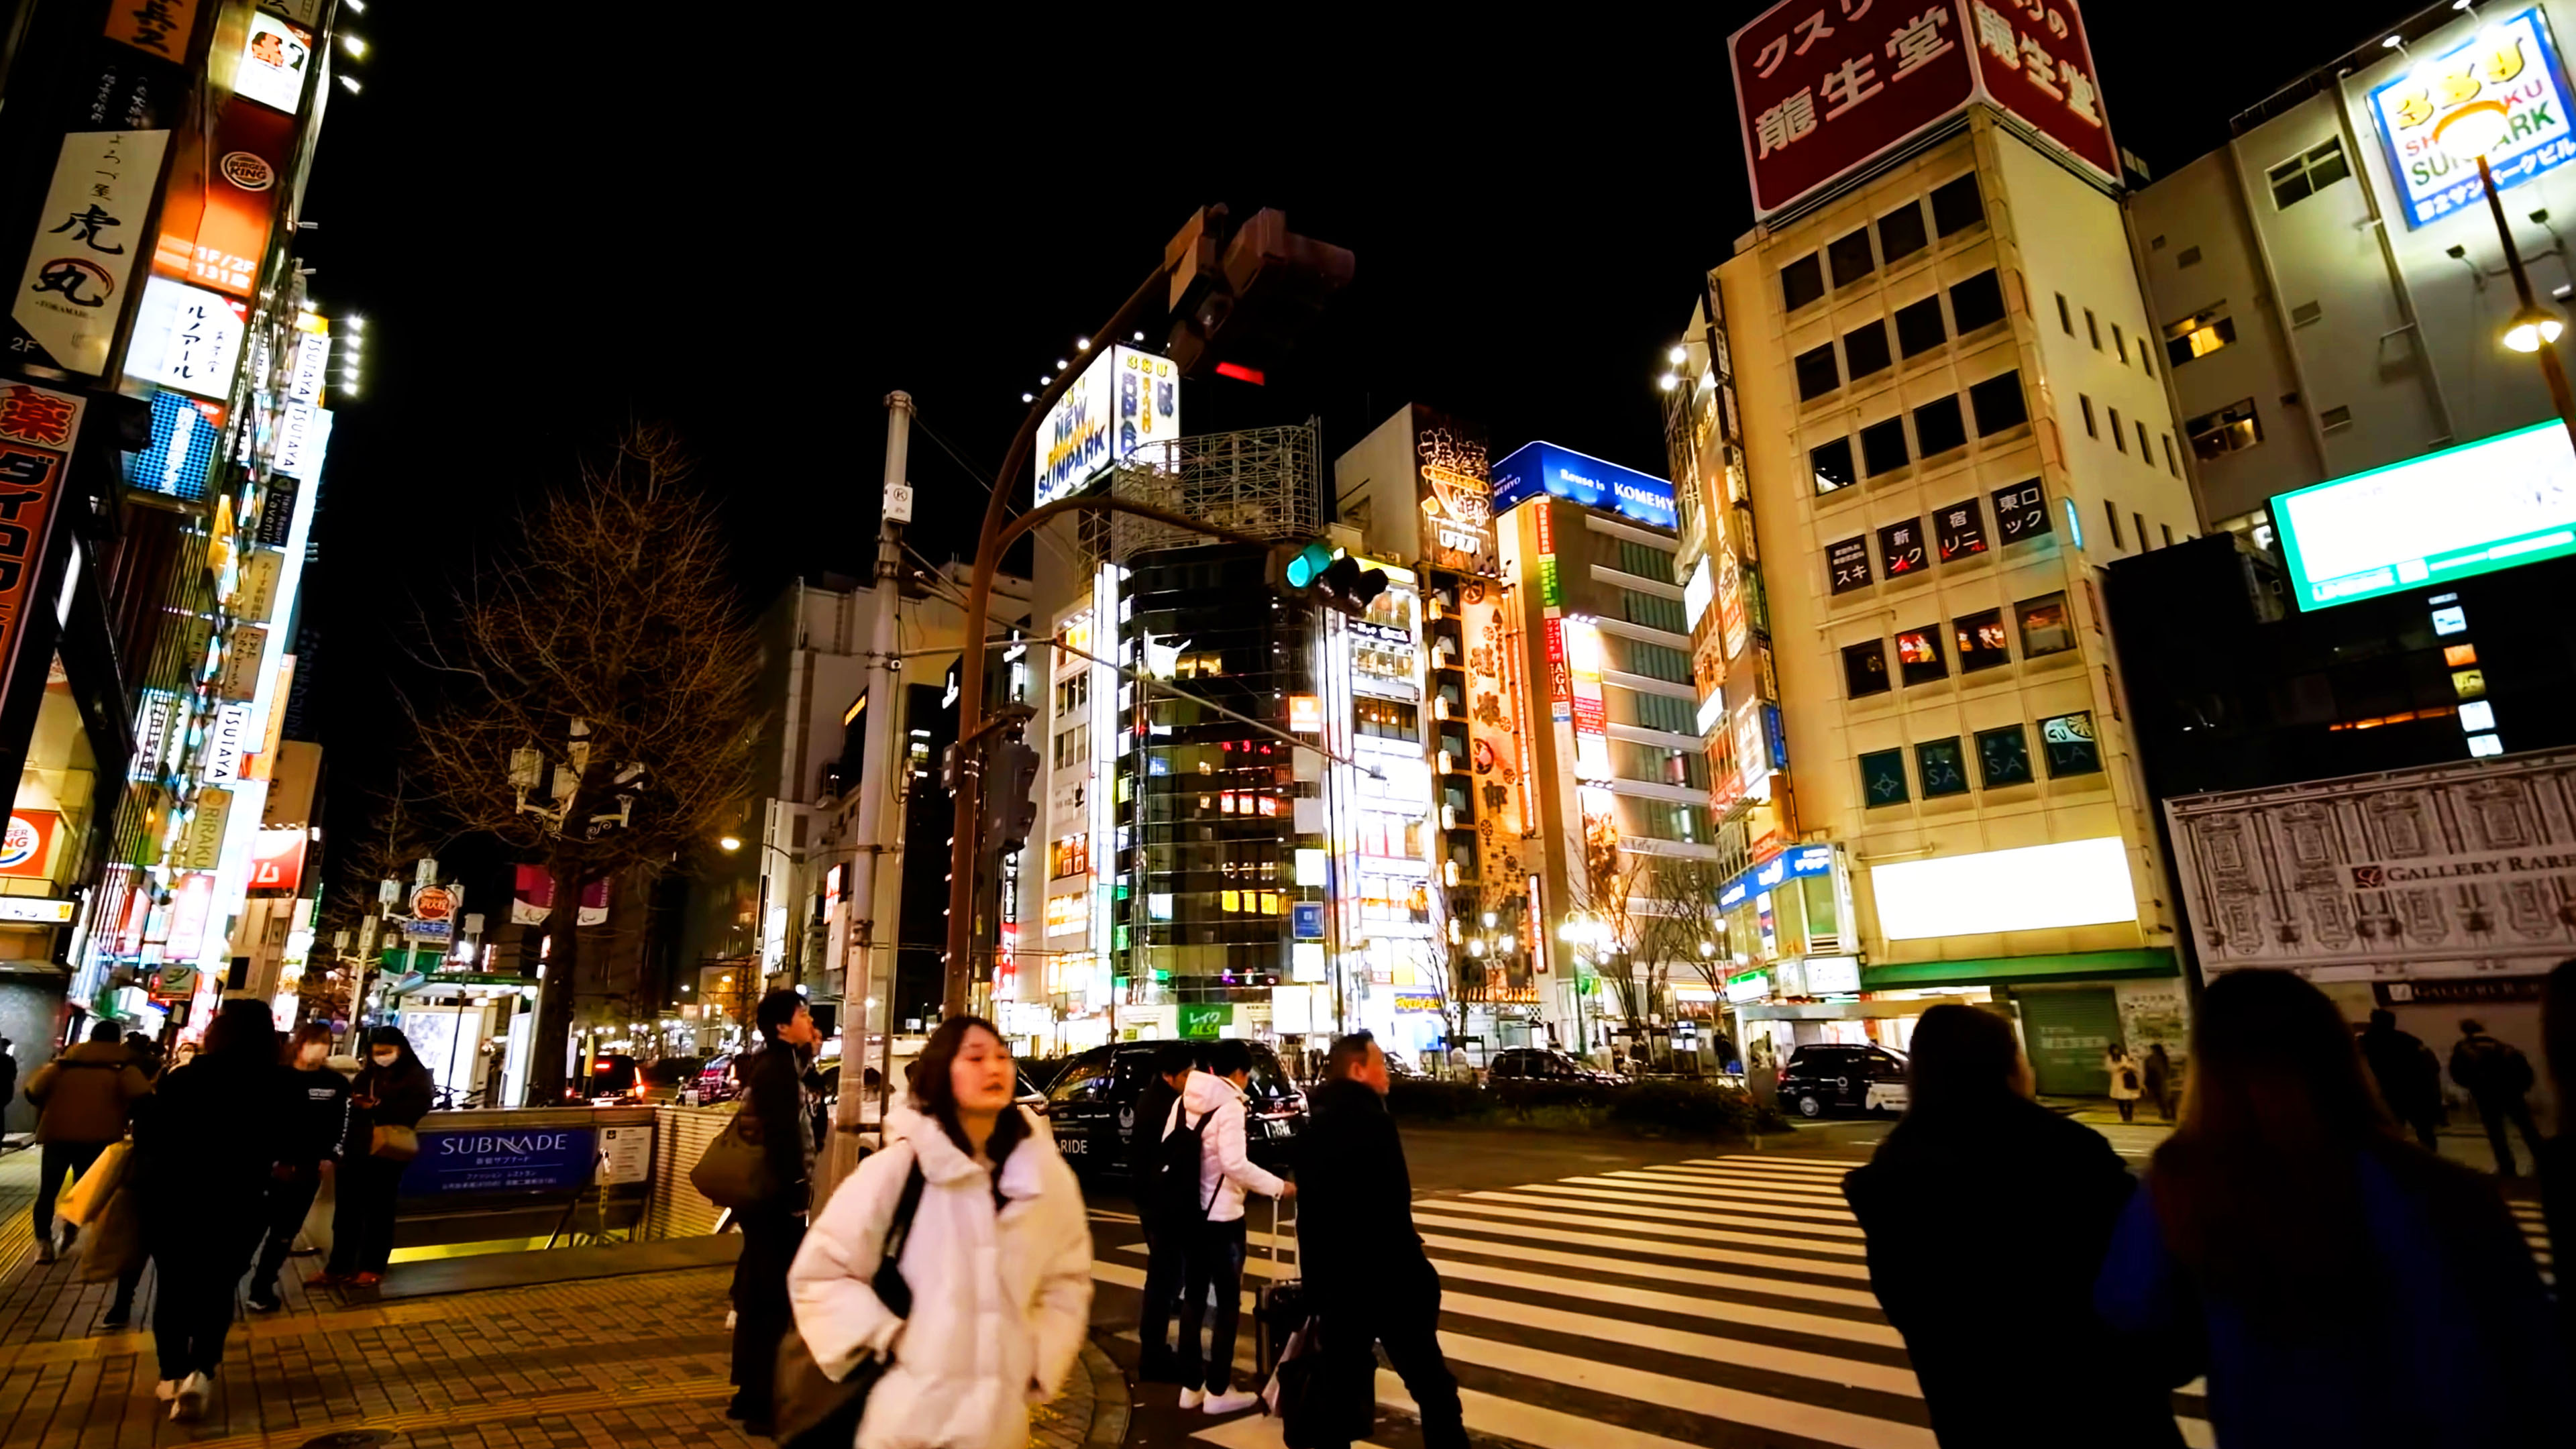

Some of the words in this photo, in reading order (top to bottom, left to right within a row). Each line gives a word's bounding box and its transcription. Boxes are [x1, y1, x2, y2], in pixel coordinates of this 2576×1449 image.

[1974, 0, 2102, 127] 龍生堂
[1756, 3, 1954, 160] 龍生堂
[2405, 79, 2543, 157] SHKU
[2412, 101, 2555, 186] SUARK
[230, 166, 267, 179] KING
[31, 203, 125, 309] 虎丸
[197, 246, 256, 273] 1F/2F
[9, 337, 36, 353] 2F
[173, 305, 207, 379] ルノアール
[299, 337, 323, 396] TSUTAYA
[283, 408, 307, 467] TSUTAYA
[1038, 424, 1106, 500] SUNPARK
[1560, 469, 1594, 489] Reuse
[1596, 479, 1605, 492] is
[1999, 487, 2040, 513] 東口
[1949, 511, 1967, 529] 宿
[1893, 529, 1911, 546] 新
[1836, 565, 1867, 586] スキ
[1554, 661, 1566, 696] AGA
[213, 711, 242, 778] TSUTAYA
[2387, 859, 2500, 881] GALLERY
[439, 1134, 568, 1155] SUBNADE
[1060, 1140, 1088, 1154] RIDE
